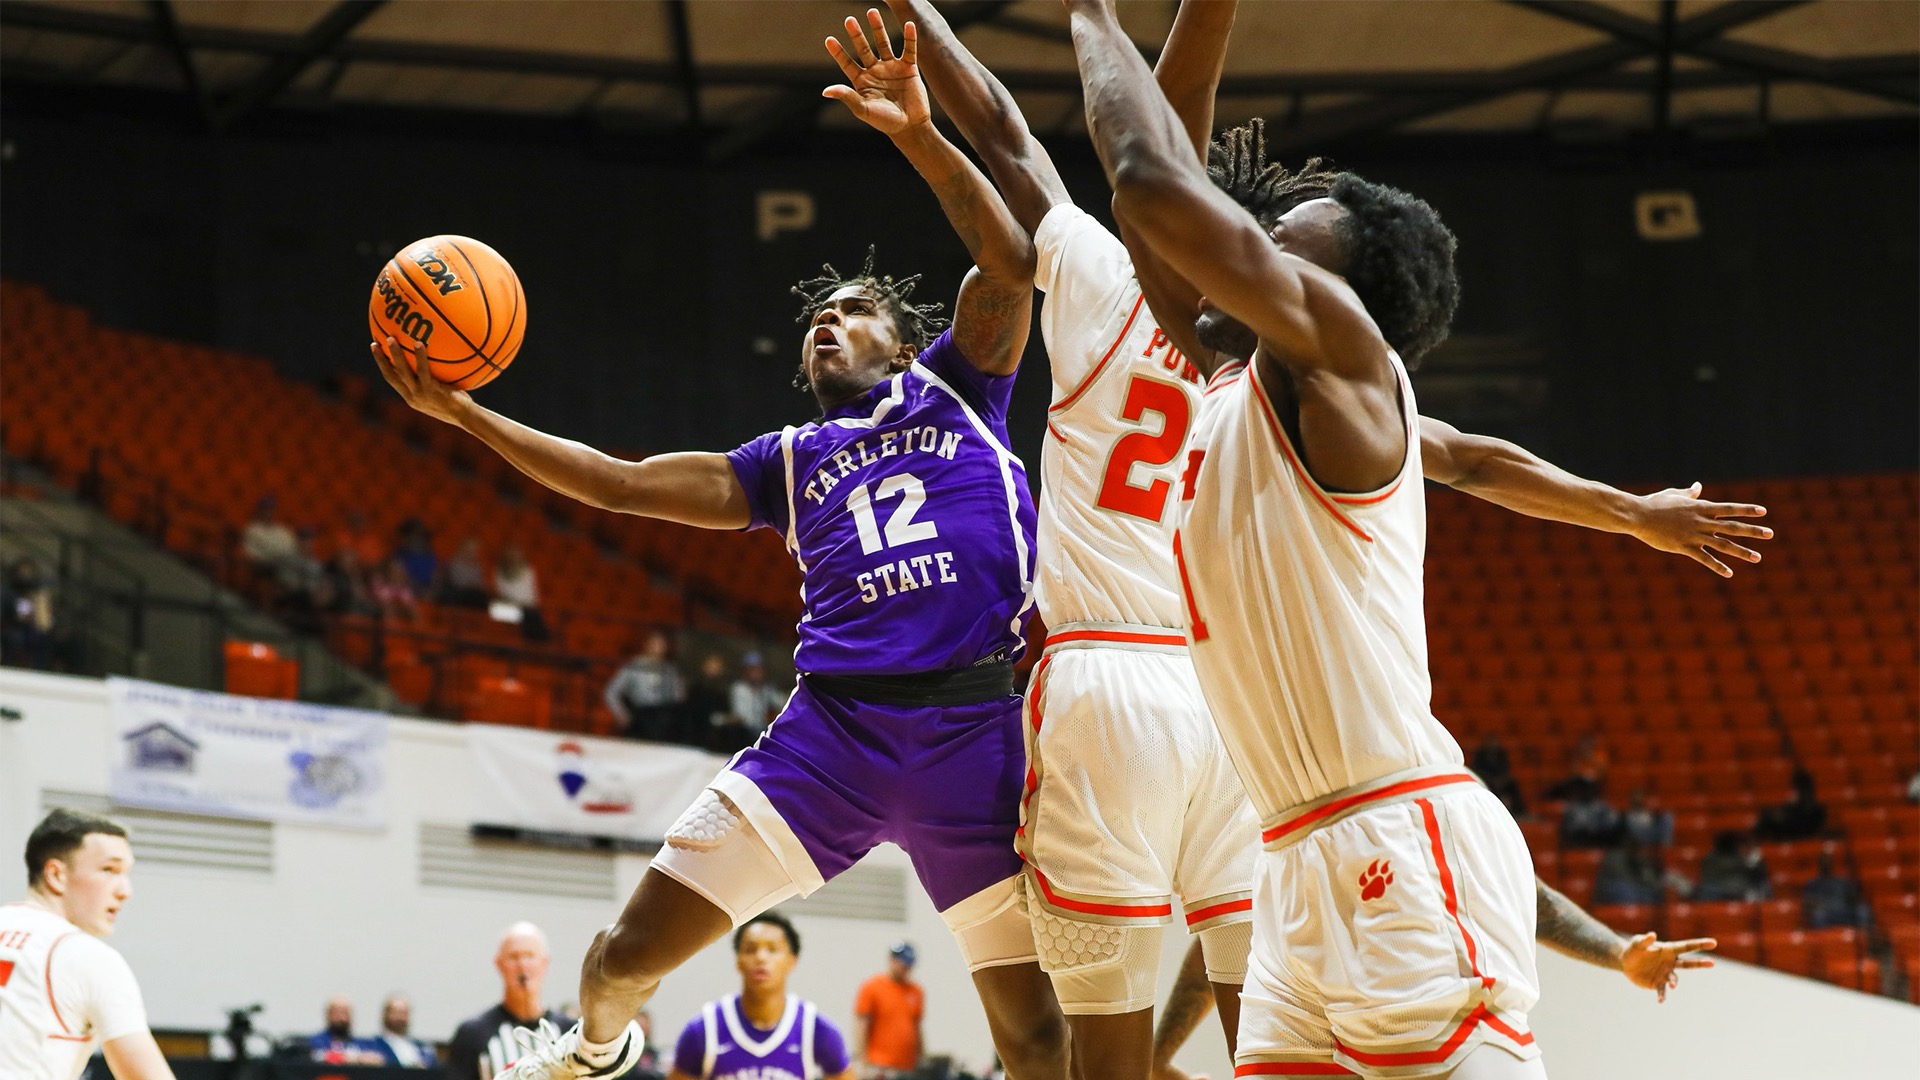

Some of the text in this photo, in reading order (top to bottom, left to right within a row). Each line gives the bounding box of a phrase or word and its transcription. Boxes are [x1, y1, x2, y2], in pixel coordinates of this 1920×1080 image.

[757, 191, 813, 239] P
[1636, 192, 1701, 238] Q
[804, 426, 963, 505] TARLETON
[846, 472, 938, 555] 12
[856, 551, 957, 604] STATE
